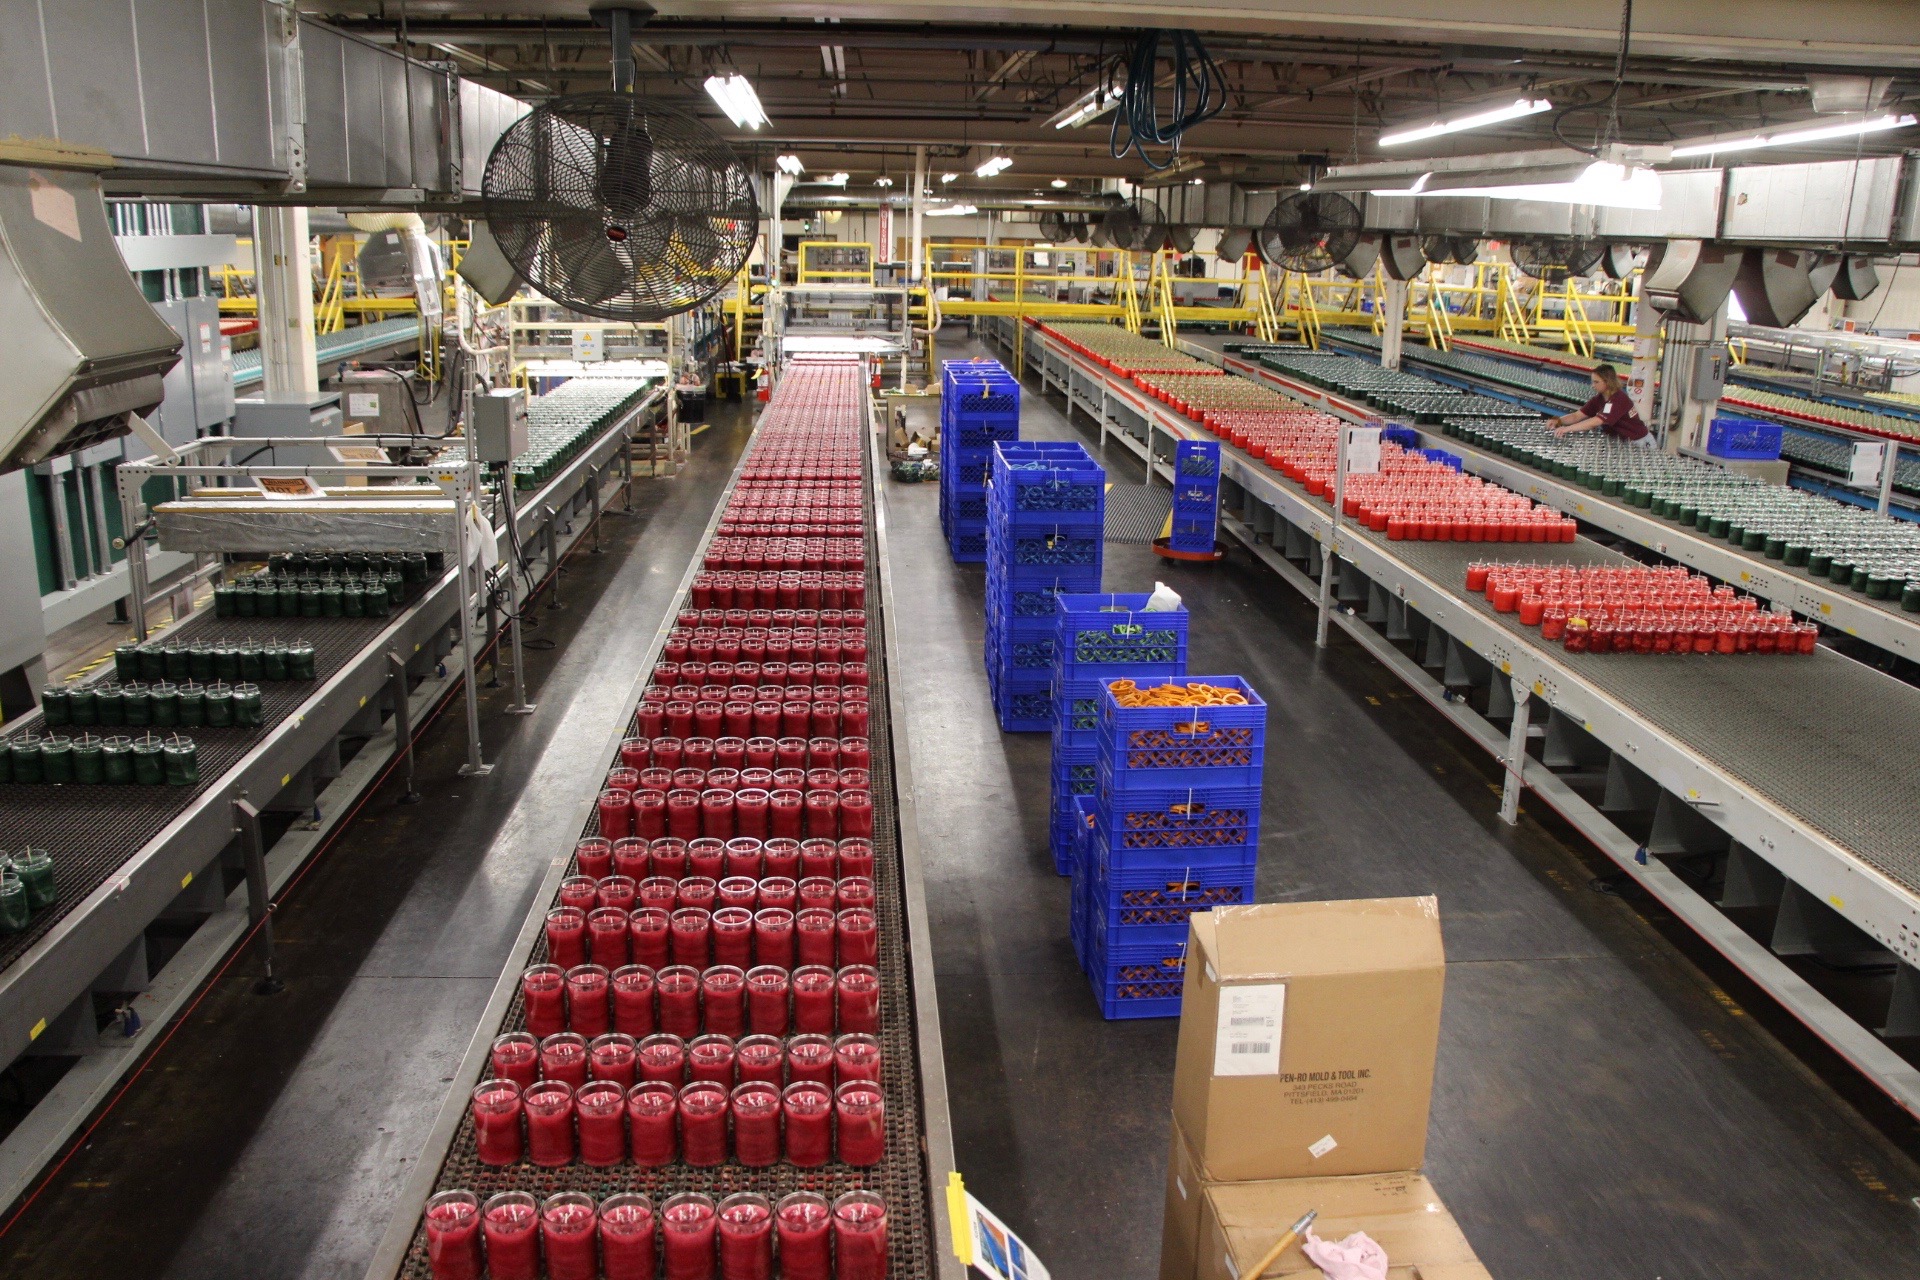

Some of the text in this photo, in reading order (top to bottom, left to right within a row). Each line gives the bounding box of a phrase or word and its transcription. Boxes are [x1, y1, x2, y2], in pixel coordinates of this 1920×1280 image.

[265, 486, 292, 494] HOT
[1280, 1068, 1371, 1083] PEN-RO MOLD & TOOL INC.
